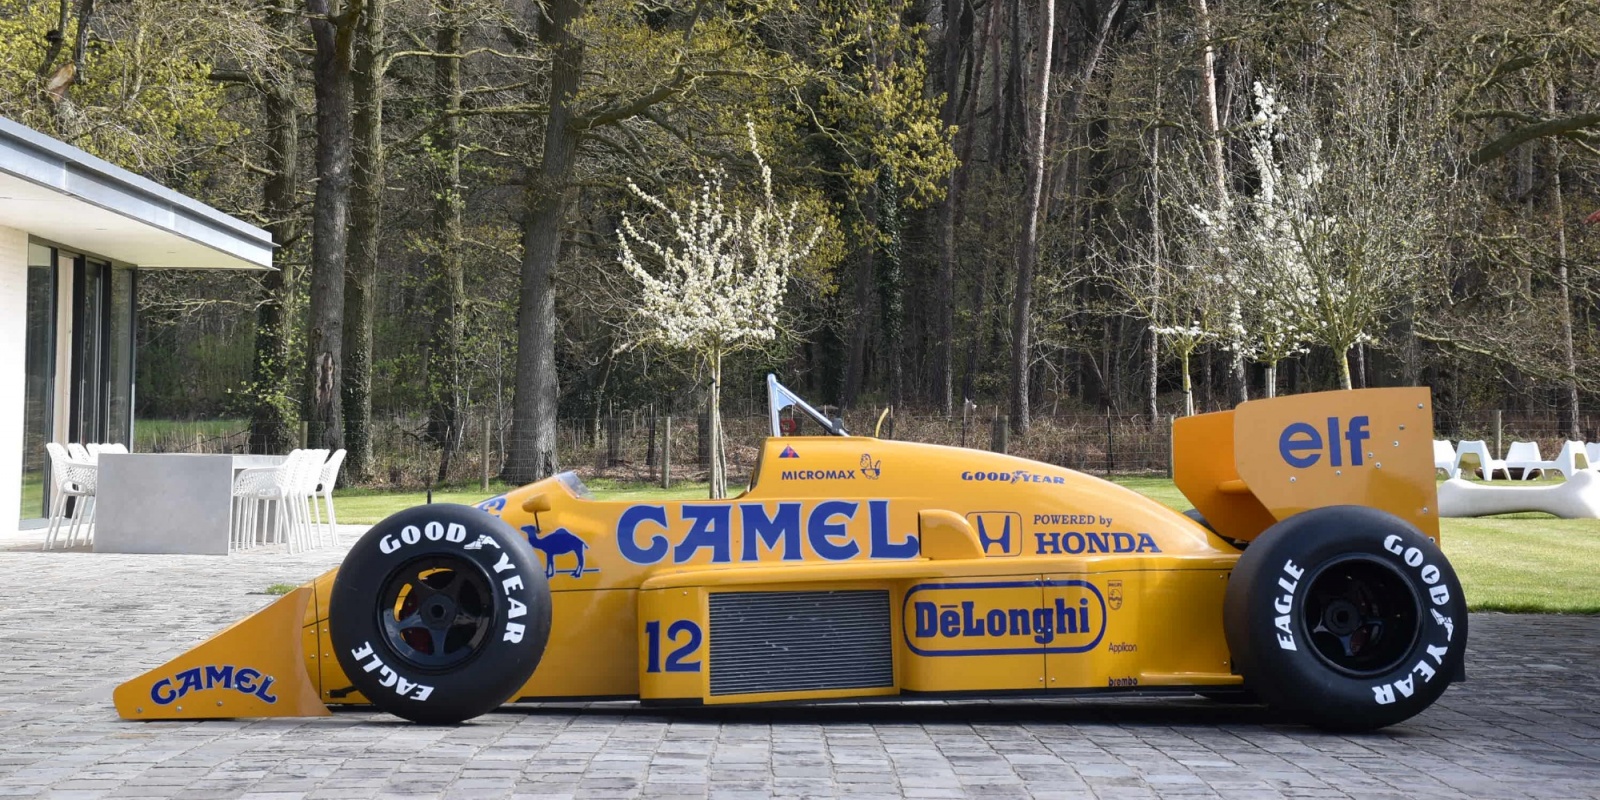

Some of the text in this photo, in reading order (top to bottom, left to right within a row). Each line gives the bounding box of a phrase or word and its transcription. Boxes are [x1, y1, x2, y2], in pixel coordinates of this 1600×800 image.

[1279, 416, 1371, 468] elf
[781, 470, 856, 480] MICROMAX
[961, 470, 1066, 485] GOODYEAR
[616, 500, 920, 566] CAMEL
[1034, 514, 1113, 528] POWERED by
[1034, 532, 1163, 555] HONDA
[1273, 558, 1305, 652] EAGLE
[645, 618, 703, 674] 12
[150, 664, 278, 706] CAMEL
[351, 641, 436, 702] EAGLE
[1108, 676, 1139, 687] brembo
